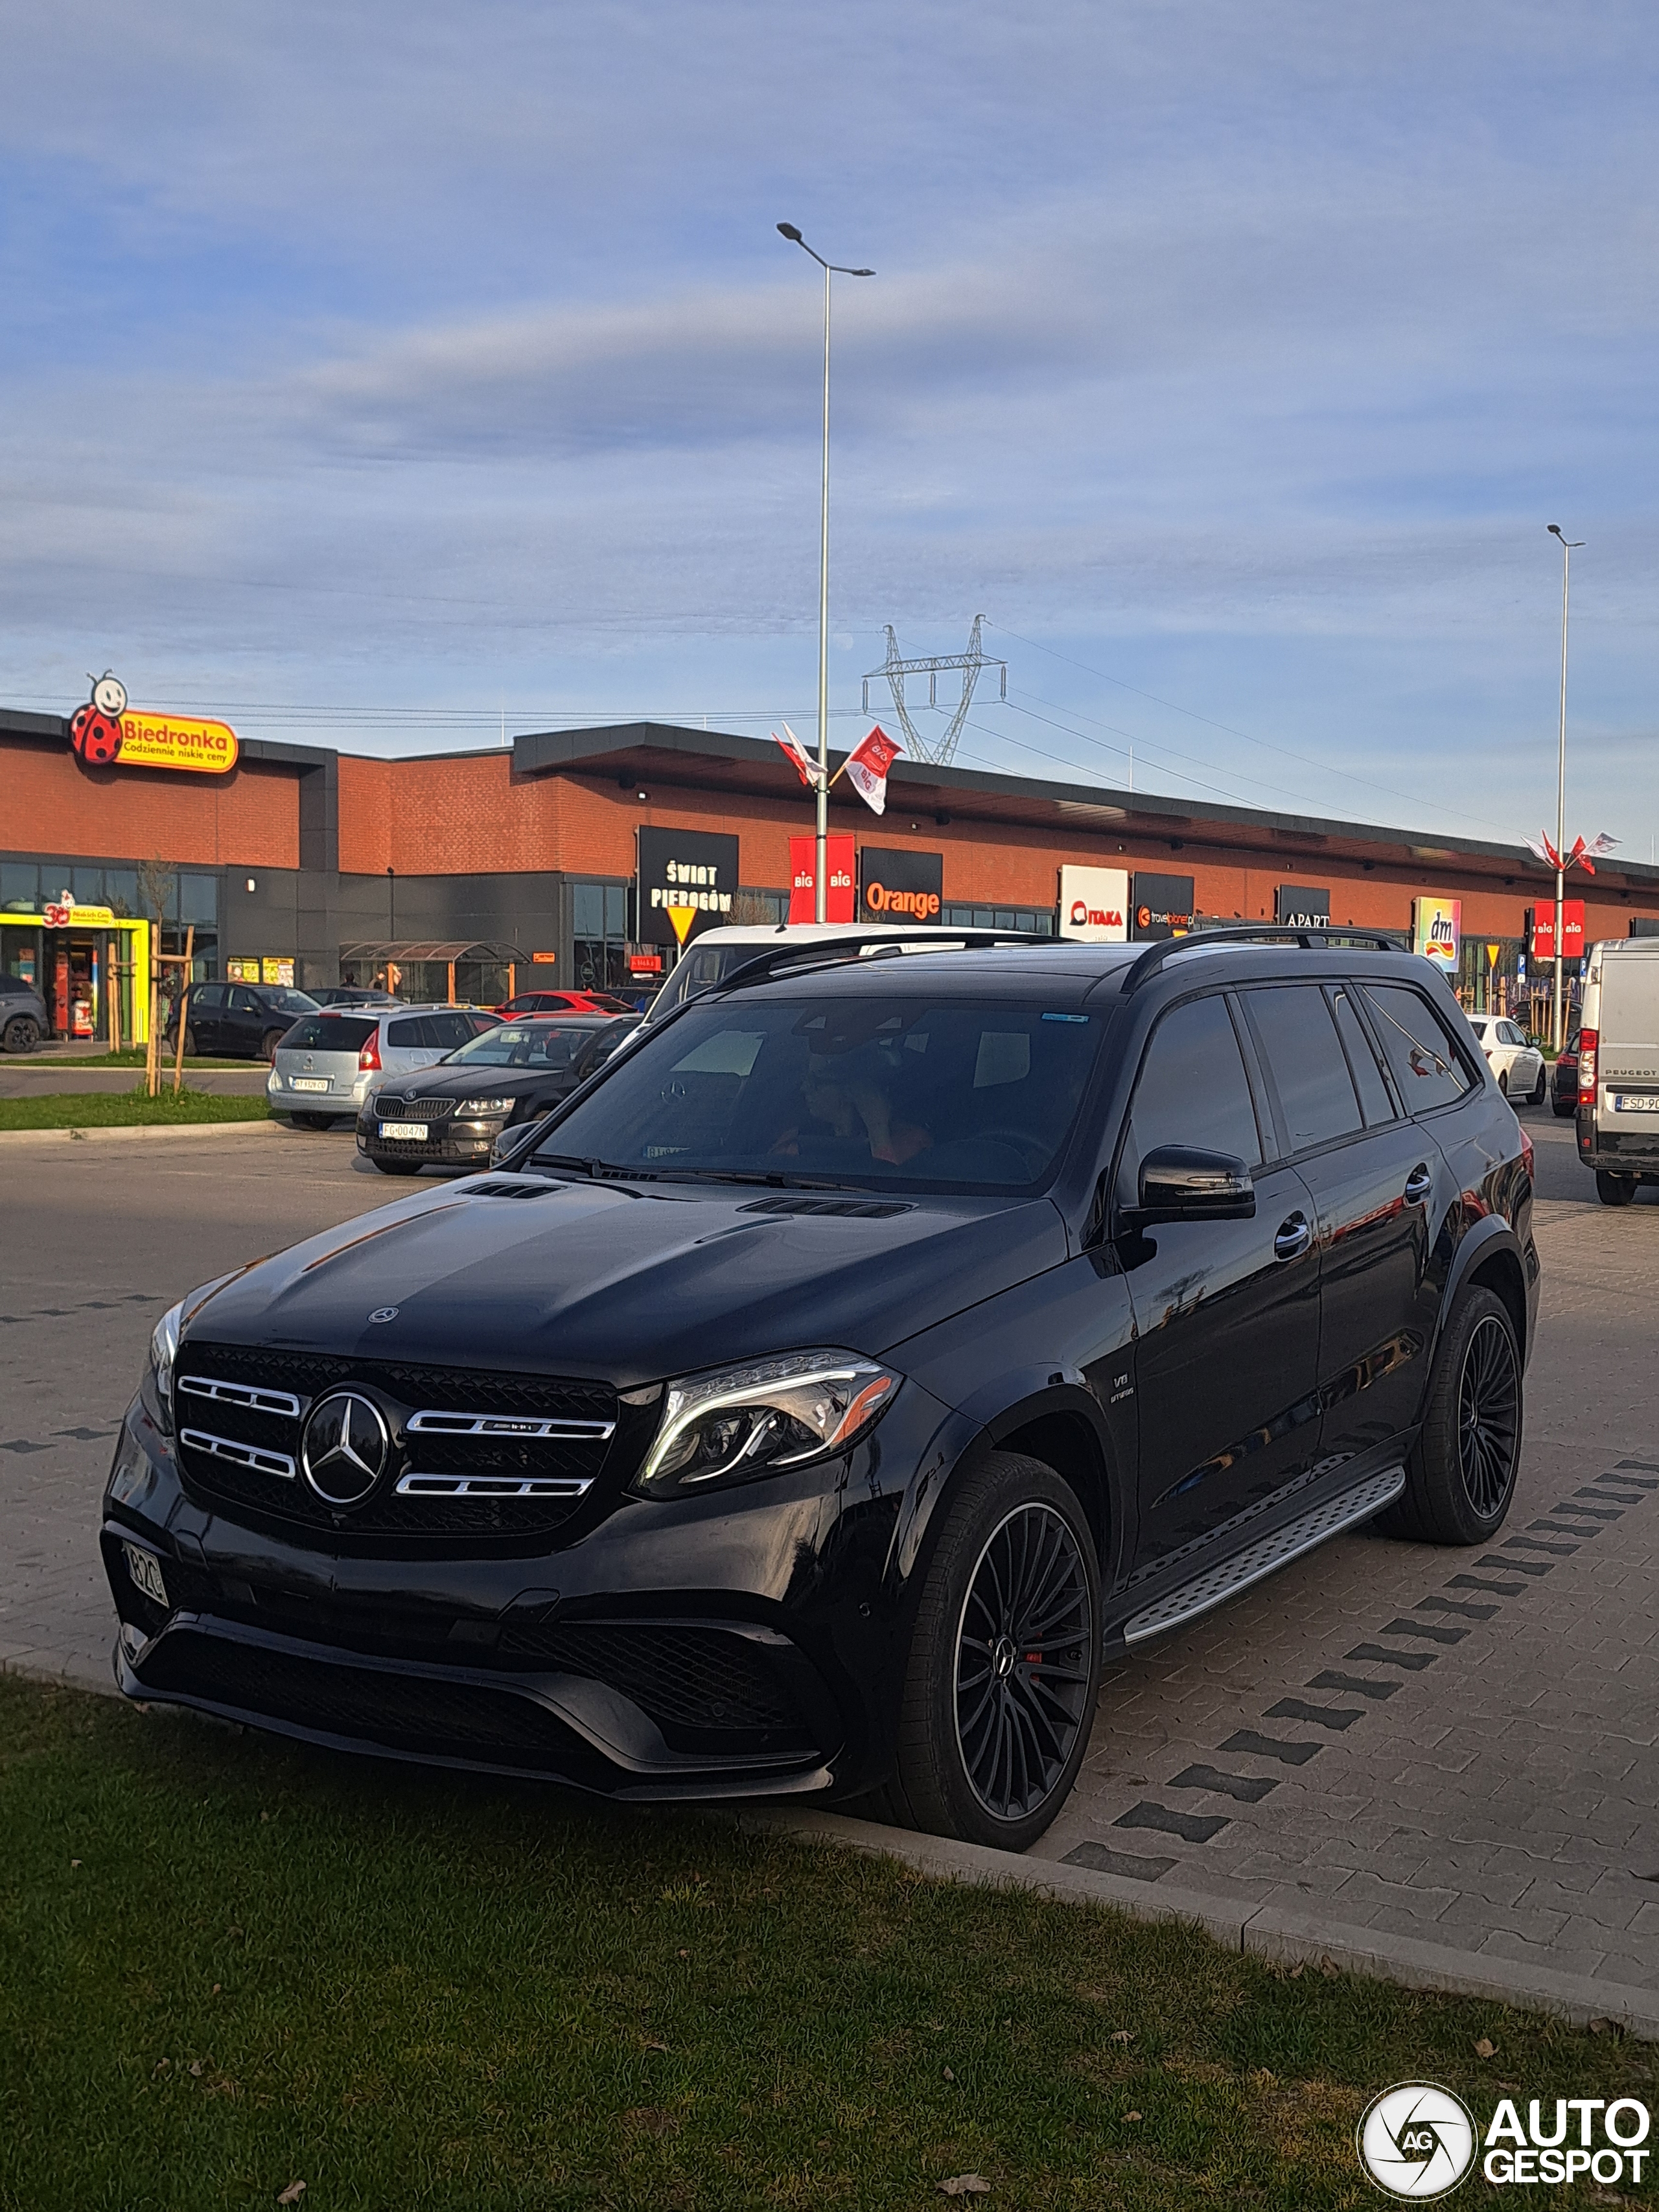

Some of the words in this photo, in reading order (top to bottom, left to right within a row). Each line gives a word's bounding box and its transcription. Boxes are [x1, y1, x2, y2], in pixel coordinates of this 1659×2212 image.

[124, 719, 227, 751] Biedronka
[124, 741, 175, 756] Codziennie
[178, 748, 204, 759] niskie
[207, 753, 227, 763] ceny
[867, 882, 940, 920] Orange
[1088, 909, 1123, 927] ITAKA
[1288, 913, 1330, 927] APART
[1431, 911, 1452, 941] dm
[1623, 1098, 1645, 1109] FSD
